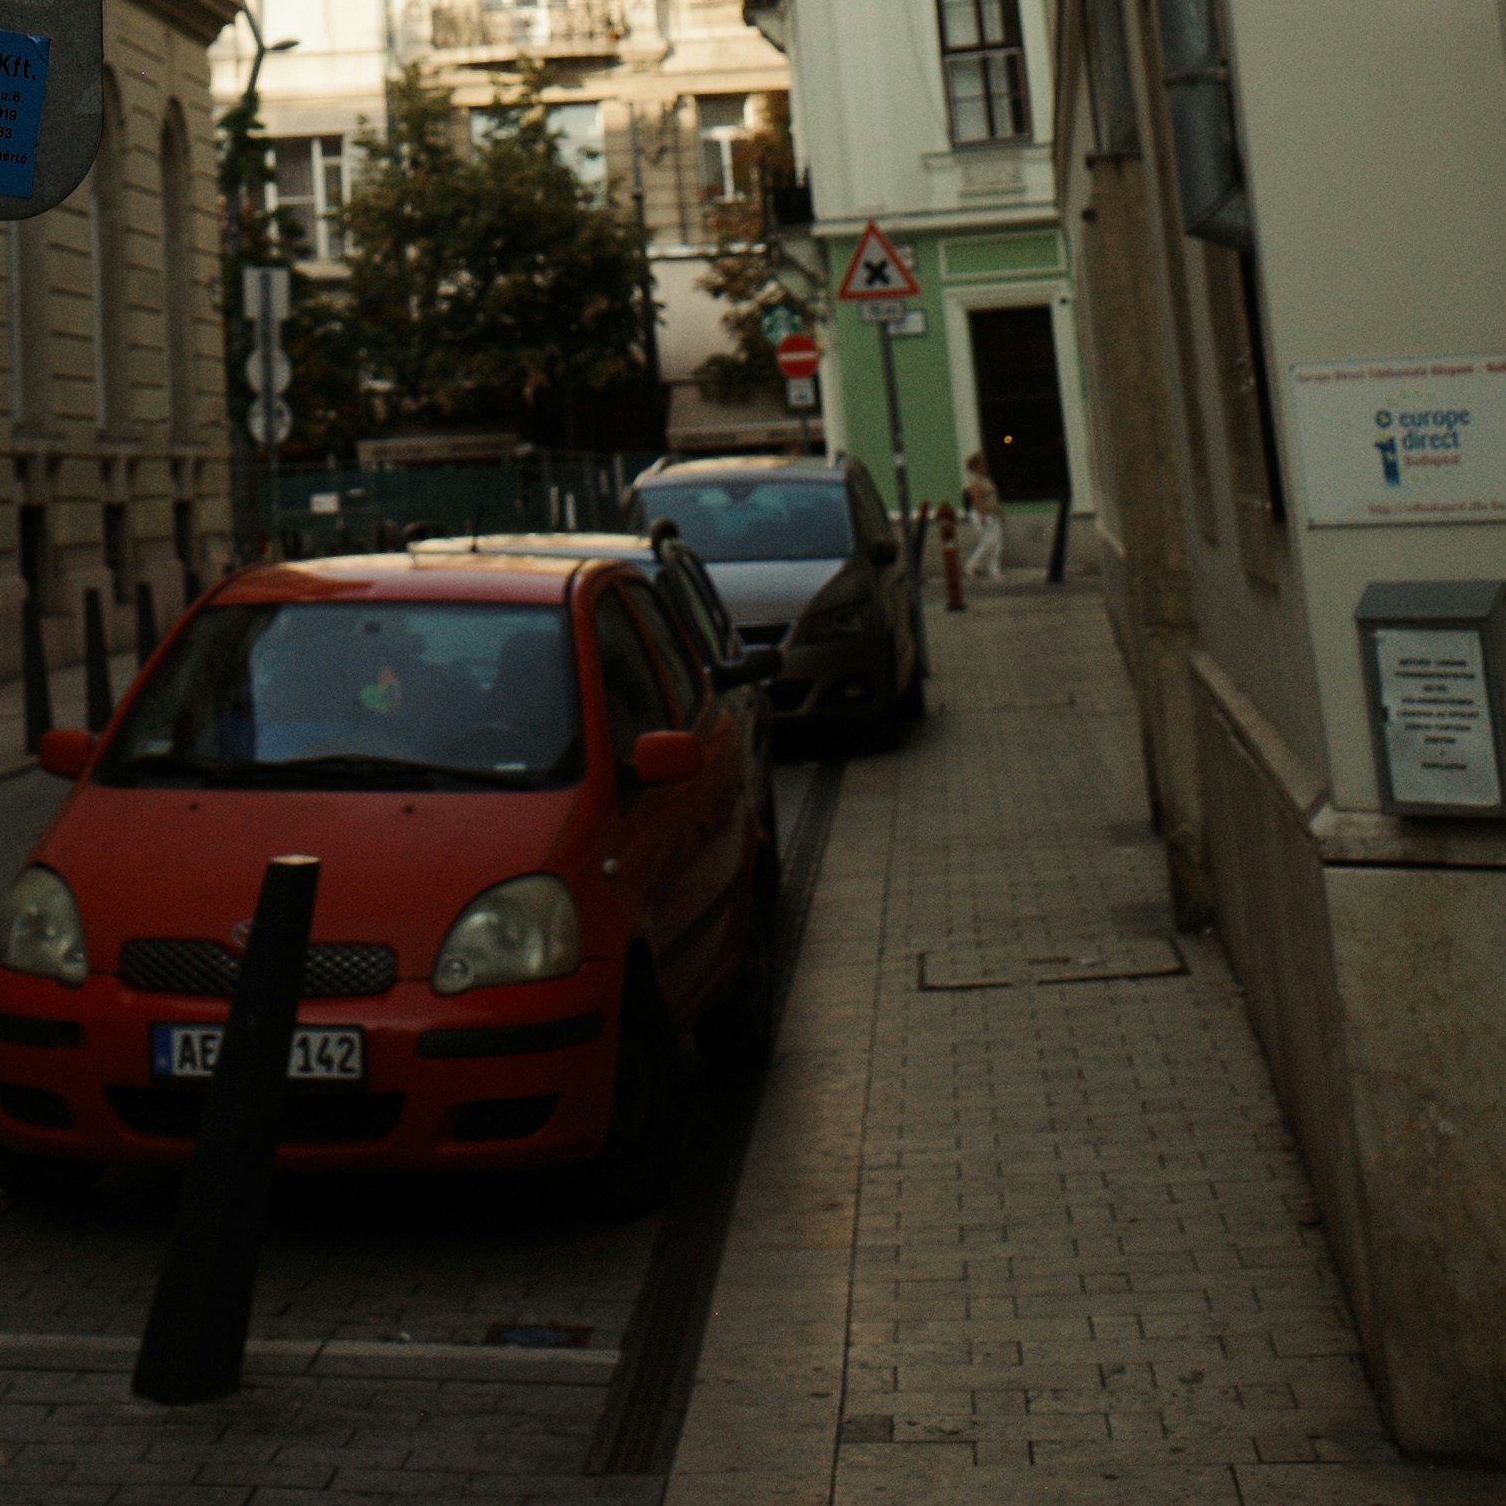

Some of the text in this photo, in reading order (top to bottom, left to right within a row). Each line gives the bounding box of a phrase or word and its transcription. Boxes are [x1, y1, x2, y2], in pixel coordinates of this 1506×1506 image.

[1398, 409, 1472, 431] europe
[1402, 428, 1461, 451] direct
[296, 1033, 356, 1073] 142
